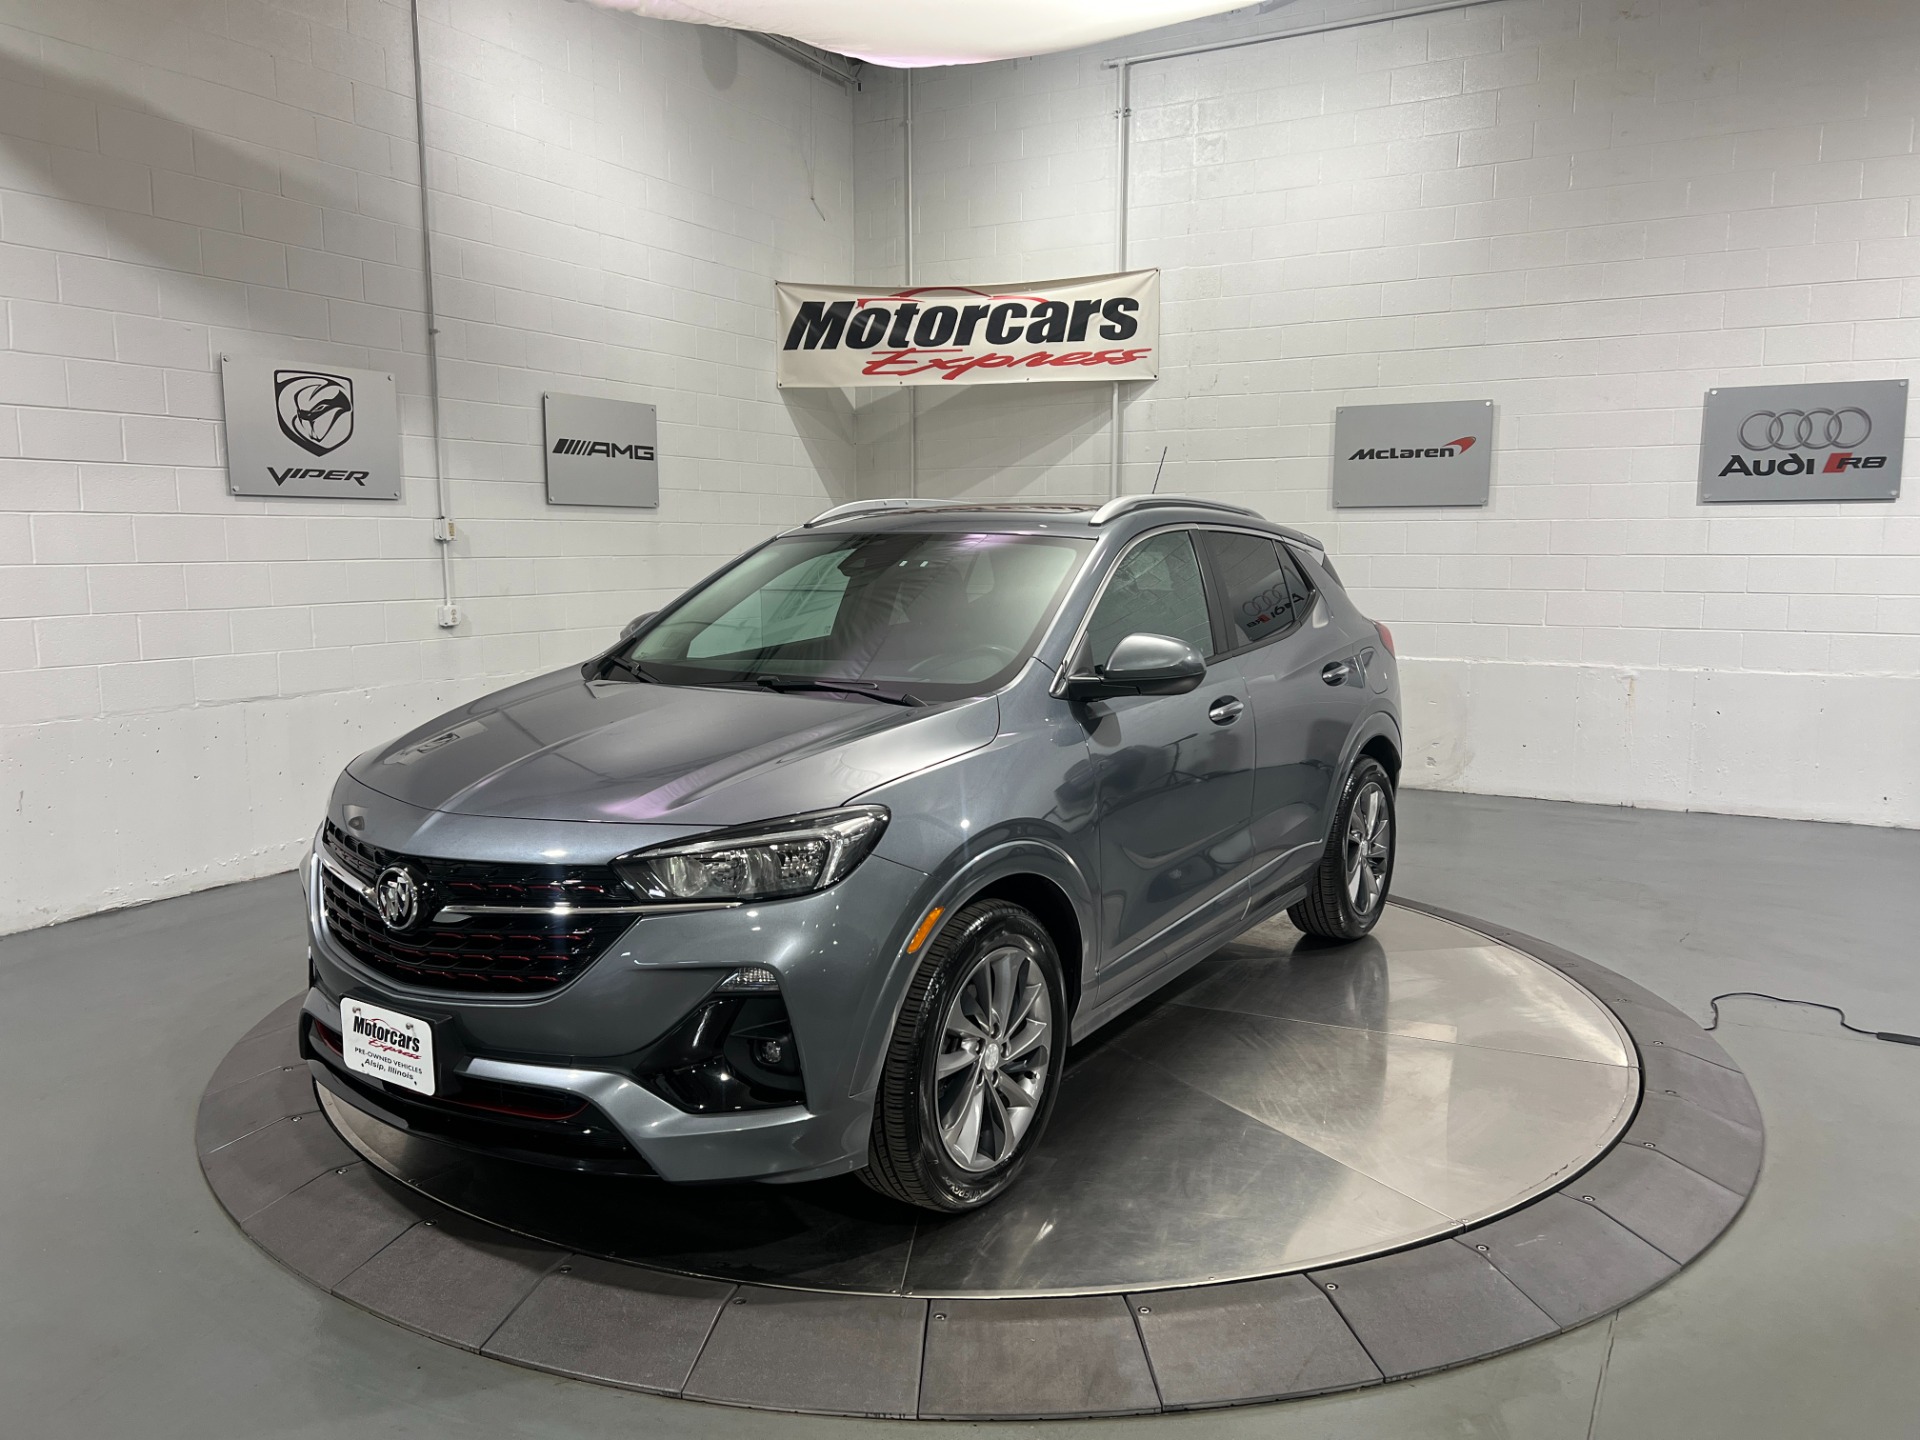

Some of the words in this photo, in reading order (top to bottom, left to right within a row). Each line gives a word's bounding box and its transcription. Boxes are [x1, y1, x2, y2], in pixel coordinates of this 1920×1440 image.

[783, 297, 1139, 350] Motorcars
[861, 347, 1152, 380] Express
[1348, 448, 1454, 460] McLaren
[1718, 453, 1815, 476] Audi
[1836, 456, 1887, 469] R8
[267, 467, 370, 486] VIPER
[353, 1016, 420, 1052] Motorcars
[354, 1046, 392, 1064] PRE-OWNED
[392, 1060, 423, 1075] VEHICLES
[368, 1039, 422, 1060] Express
[364, 1058, 386, 1072] Alsip,
[387, 1066, 414, 1080] Illinois
